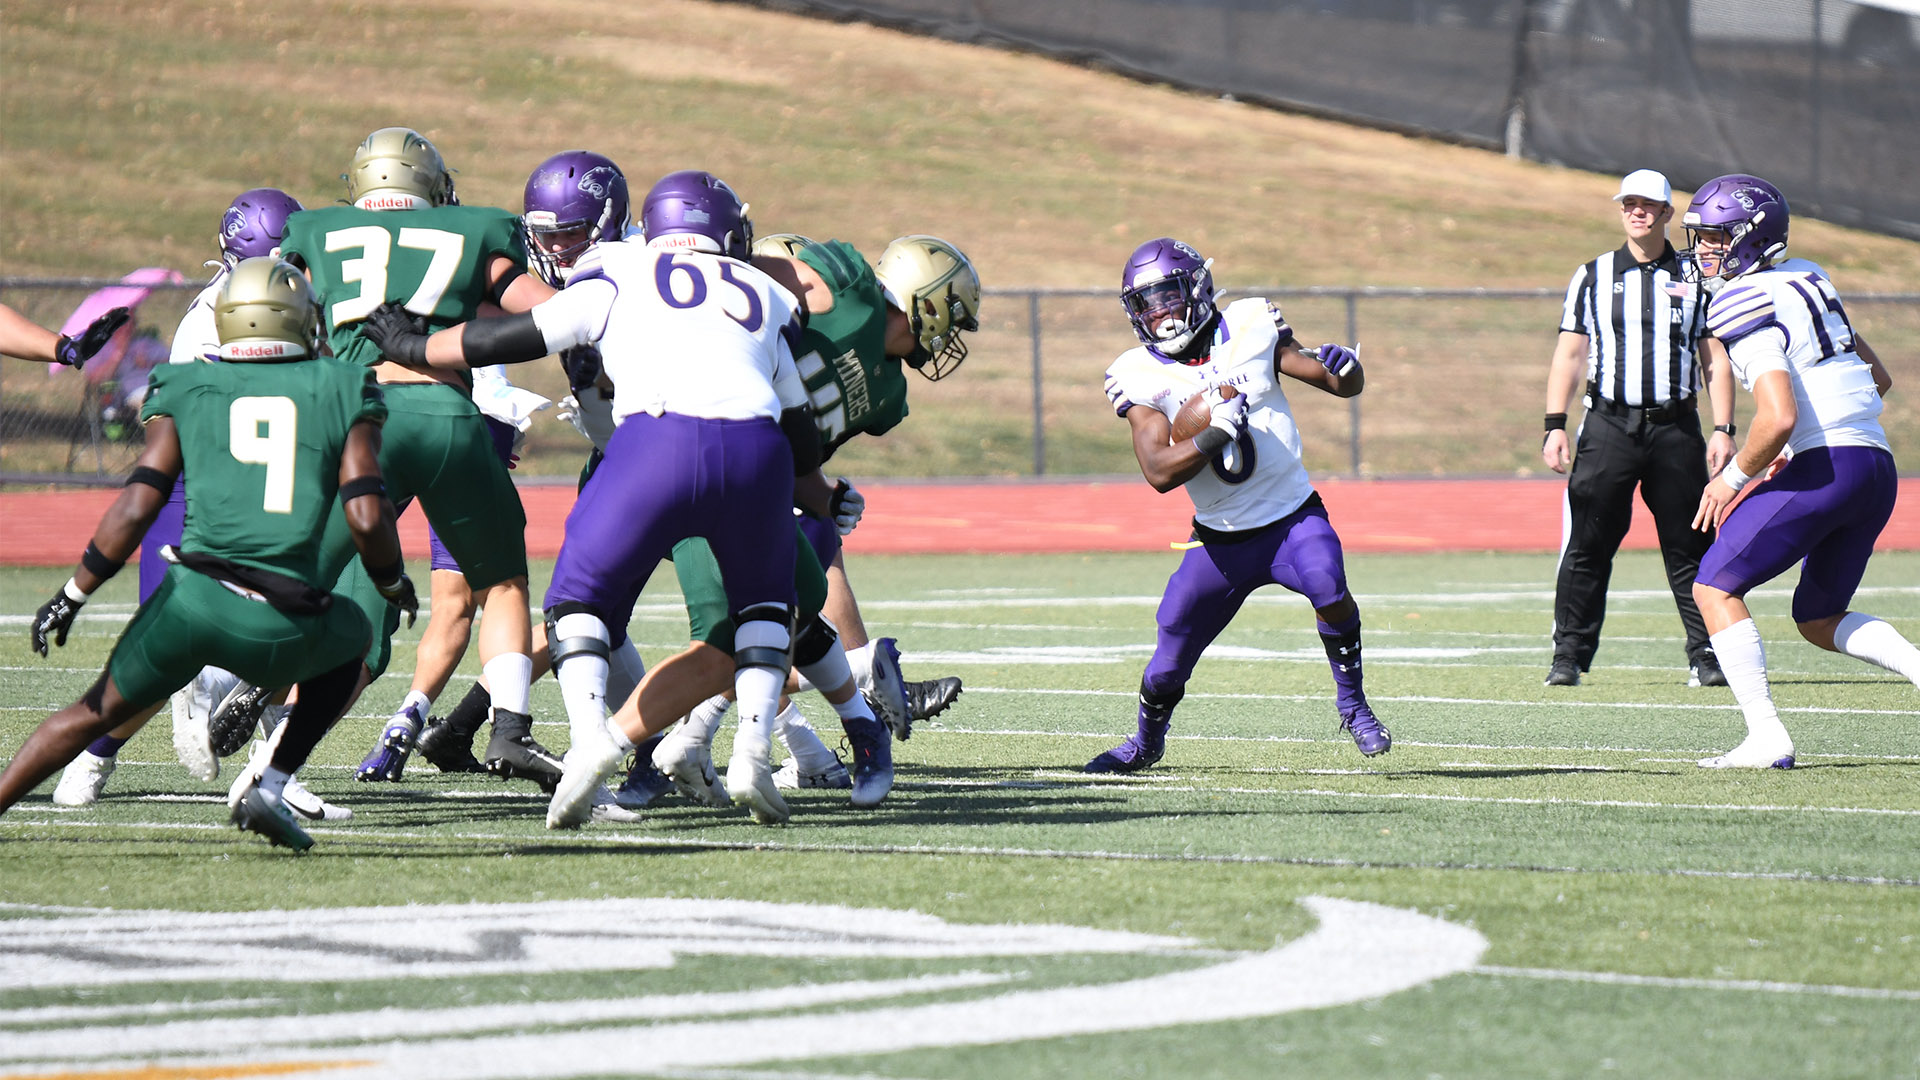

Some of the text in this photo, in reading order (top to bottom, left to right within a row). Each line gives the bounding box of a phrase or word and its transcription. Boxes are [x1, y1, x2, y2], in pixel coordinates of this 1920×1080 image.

[364, 197, 413, 209] Riddell
[324, 225, 465, 328] 37
[653, 250, 764, 335] 65
[1613, 281, 1624, 294] S
[230, 344, 284, 356] Riddell
[1785, 271, 1856, 365] 15
[832, 348, 870, 421] MINERS
[228, 395, 297, 514] 9
